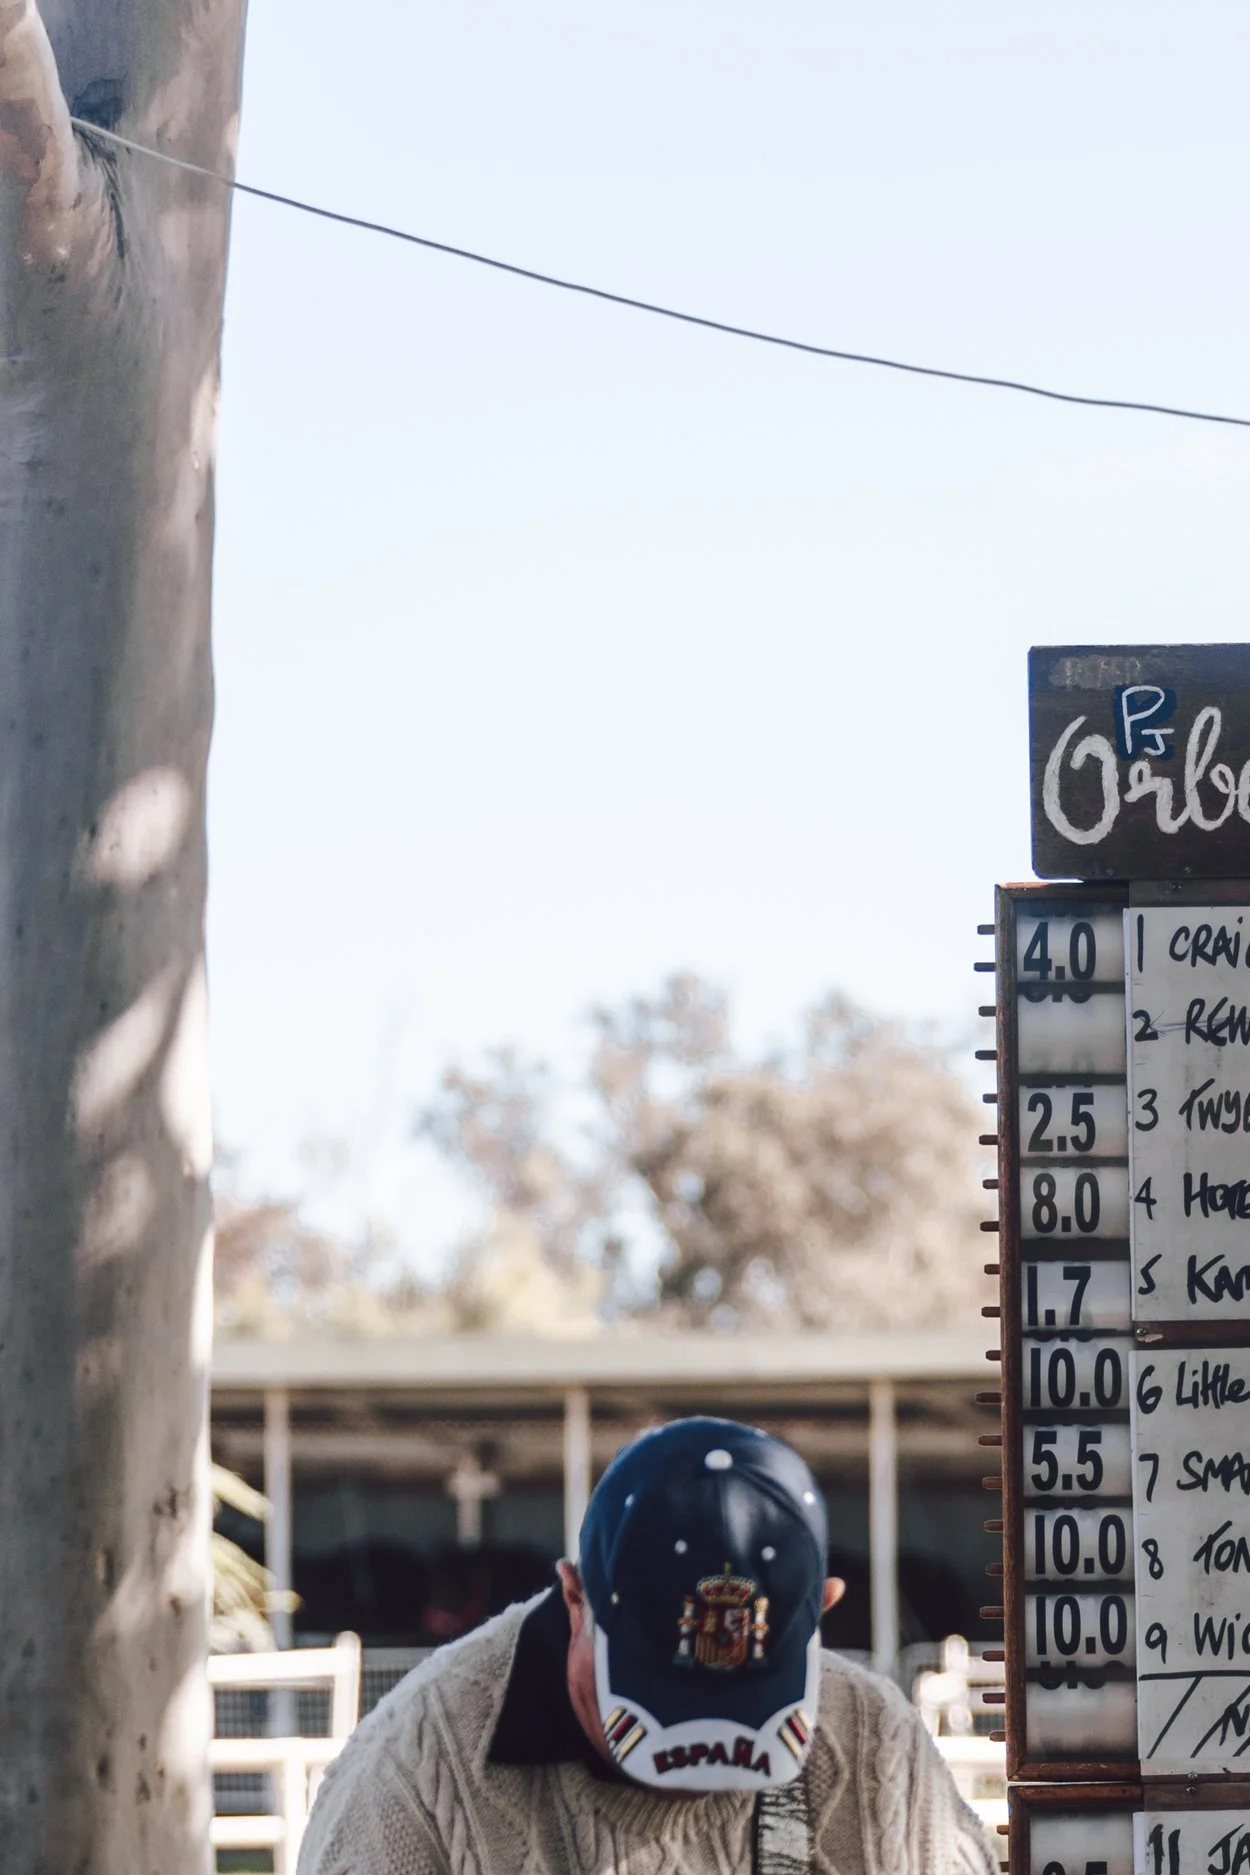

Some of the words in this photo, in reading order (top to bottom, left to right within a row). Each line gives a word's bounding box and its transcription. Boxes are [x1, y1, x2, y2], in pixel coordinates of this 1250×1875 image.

[1022, 921, 1097, 981] 4.0
[1136, 915, 1144, 973] 1
[1132, 1010, 1160, 1043] 2
[1027, 1092, 1096, 1153] 2.5
[1134, 1088, 1160, 1132] 3
[1032, 1172, 1101, 1234] 8.0
[1133, 1179, 1157, 1221] 4
[1027, 1265, 1092, 1327] 1.7
[1138, 1253, 1163, 1295] 5
[1028, 1347, 1123, 1409] 10.0
[1136, 1366, 1163, 1413] 6
[1031, 1431, 1102, 1493] 5.5
[1139, 1453, 1160, 1501] 7
[1033, 1513, 1127, 1576] 10.0
[1141, 1537, 1165, 1580] 8
[1034, 1595, 1128, 1656] 10.0
[1144, 1622, 1169, 1666] 9
[652, 1735, 771, 1778] ESPAÑA
